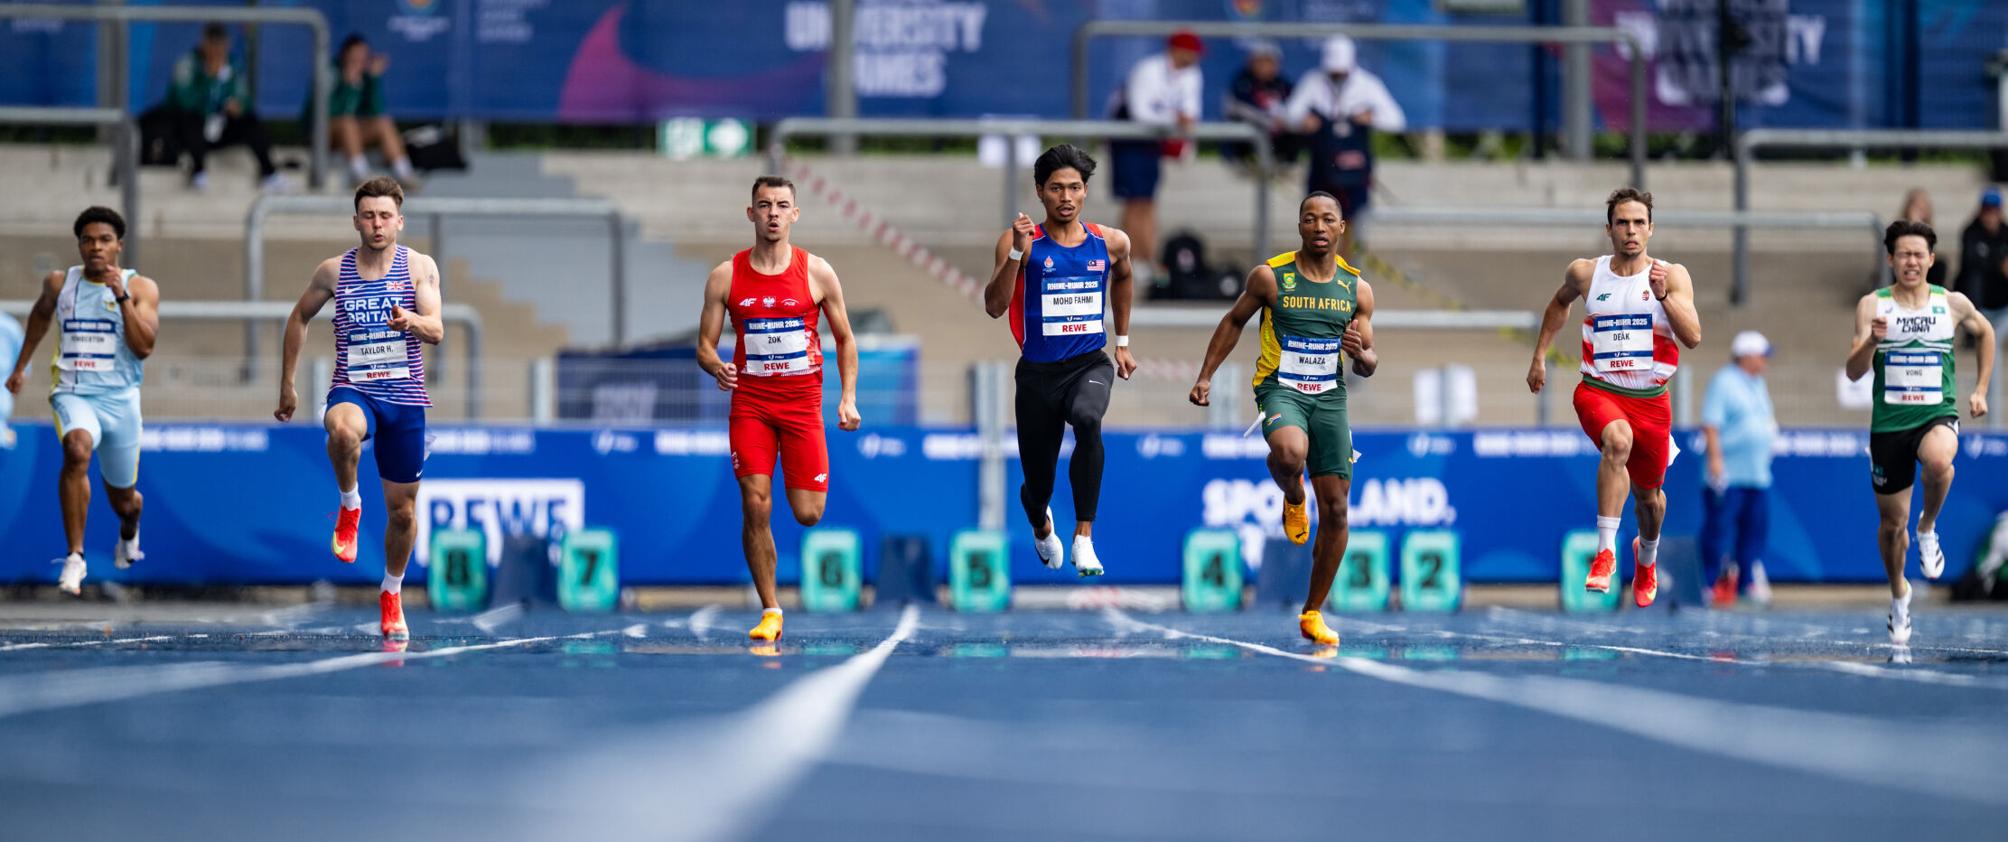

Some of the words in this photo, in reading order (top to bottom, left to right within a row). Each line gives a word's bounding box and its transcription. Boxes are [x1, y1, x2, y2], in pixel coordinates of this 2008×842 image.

[786, 3, 987, 50] UNVERSITY
[853, 51, 946, 97] AMES
[1047, 282, 1084, 291] RHINE-RUHR
[1085, 281, 1098, 289] 2025
[344, 297, 403, 311] GREAT
[1053, 297, 1073, 305] MOHD
[1074, 296, 1093, 304] FAHMI
[1283, 296, 1316, 309] SOUTH
[1318, 298, 1352, 312] AFRICA
[348, 310, 394, 323] BRITA
[1632, 318, 1647, 326] 2025
[1896, 317, 1936, 325] MACAU
[1062, 324, 1087, 332] REWE
[1902, 325, 1930, 333] CHINA
[361, 346, 385, 355] TAYLOR
[386, 345, 394, 353] H.
[764, 362, 790, 371] REWE
[1299, 357, 1325, 365] WALAZA
[1610, 360, 1634, 368] REWE
[1297, 383, 1321, 391] REWE
[578, 550, 599, 585] 7
[820, 551, 843, 588] 6
[968, 551, 992, 588] 5
[1202, 552, 1224, 587] 4
[1350, 552, 1371, 588] 3
[1419, 552, 1442, 588] 2
